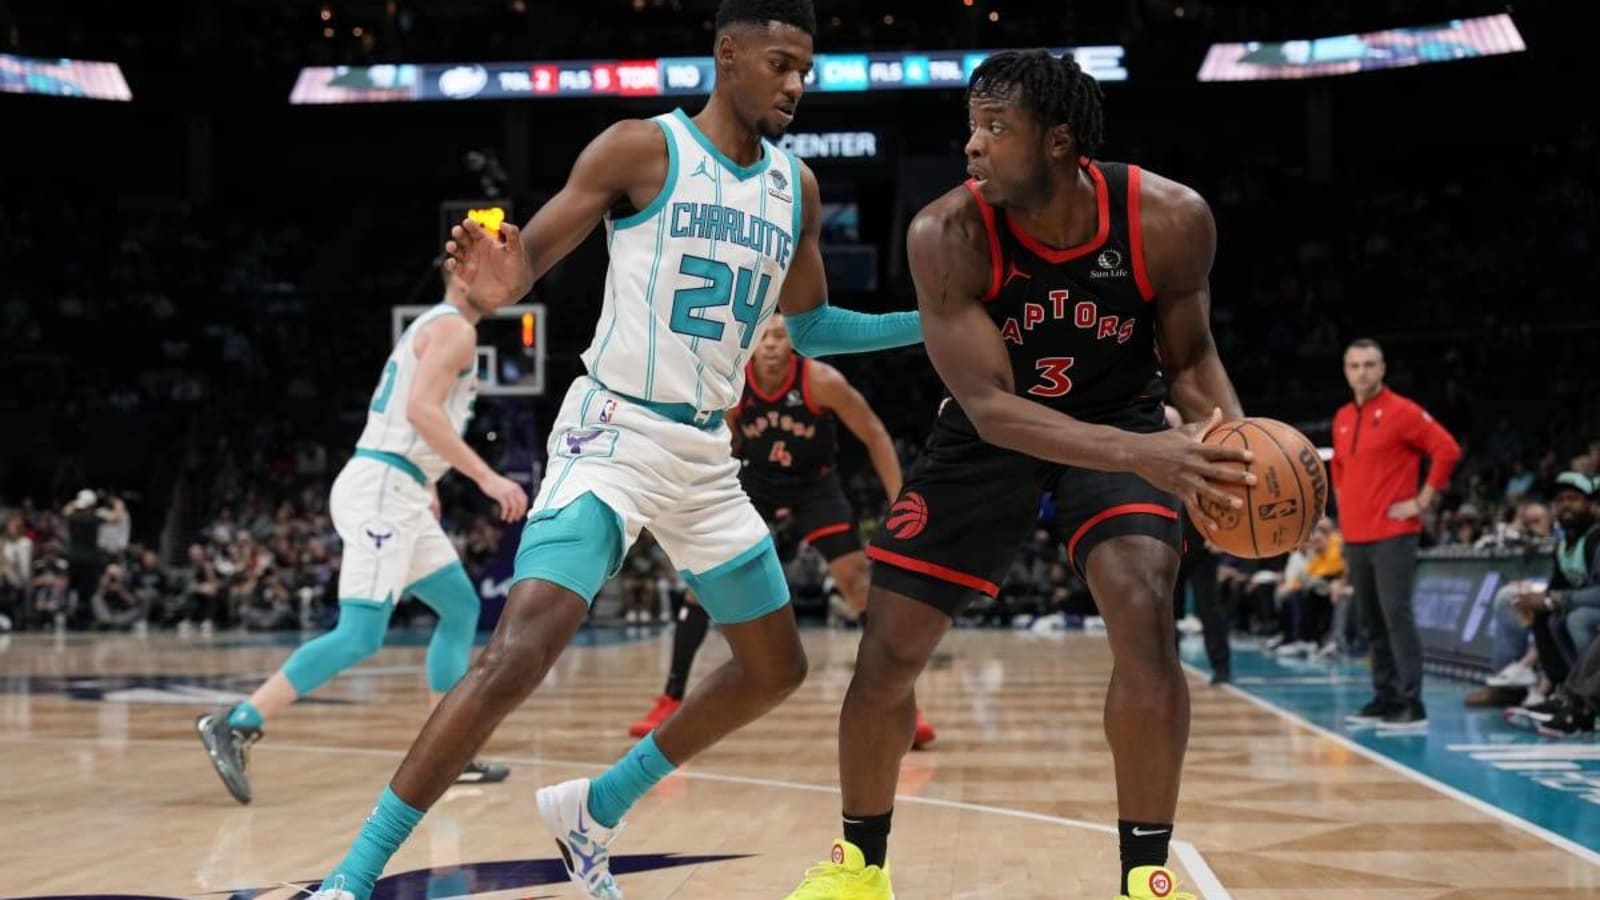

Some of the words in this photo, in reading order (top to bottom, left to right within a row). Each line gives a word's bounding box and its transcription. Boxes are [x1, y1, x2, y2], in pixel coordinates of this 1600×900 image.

[779, 131, 876, 157] CENTER
[670, 202, 792, 270] CHARLOTTE
[1090, 271, 1109, 279] Sun
[1110, 269, 1129, 278] Life
[669, 253, 772, 349] 24
[1001, 289, 1136, 345] APTORS
[1027, 357, 1074, 397] 3
[768, 440, 792, 467] 4
